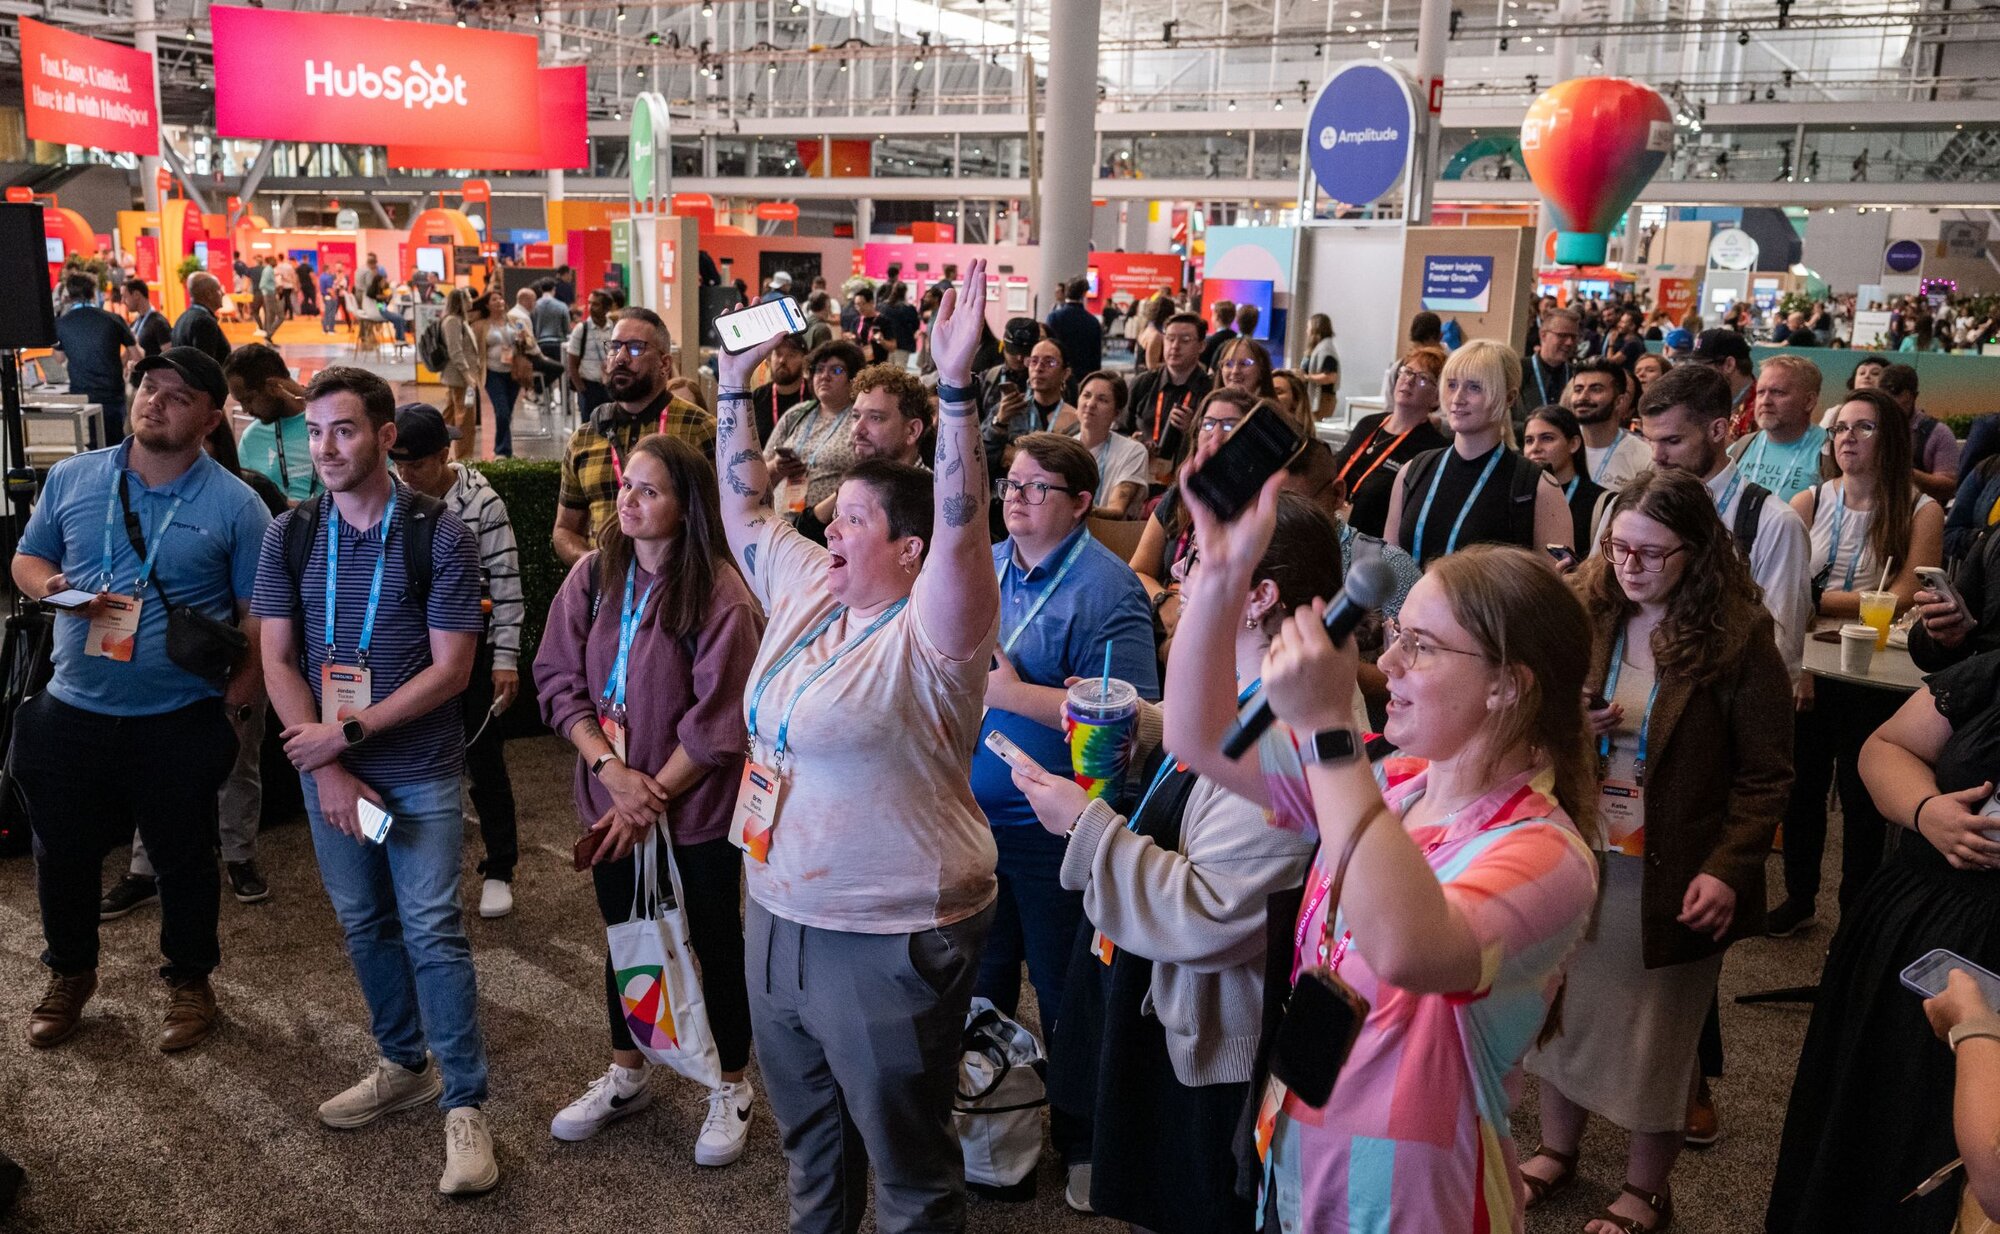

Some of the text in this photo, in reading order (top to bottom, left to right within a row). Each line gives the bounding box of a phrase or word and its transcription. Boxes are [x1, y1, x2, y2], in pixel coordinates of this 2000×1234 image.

[40, 53, 132, 93] Fast. Easy. Unified.
[305, 60, 468, 109] HubSpot
[32, 84, 148, 128] Have it all with HubSpot
[1338, 126, 1399, 145] Amplitude
[1429, 272, 1449, 282] Faster
[1430, 262, 1454, 272] Deeper
[1666, 289, 1690, 301] VIP
[1740, 462, 1803, 478] IMPULE
[873, 604, 902, 629] INBOUND
[752, 675, 771, 709] INBOUND
[1296, 898, 1317, 948] INBOUND
